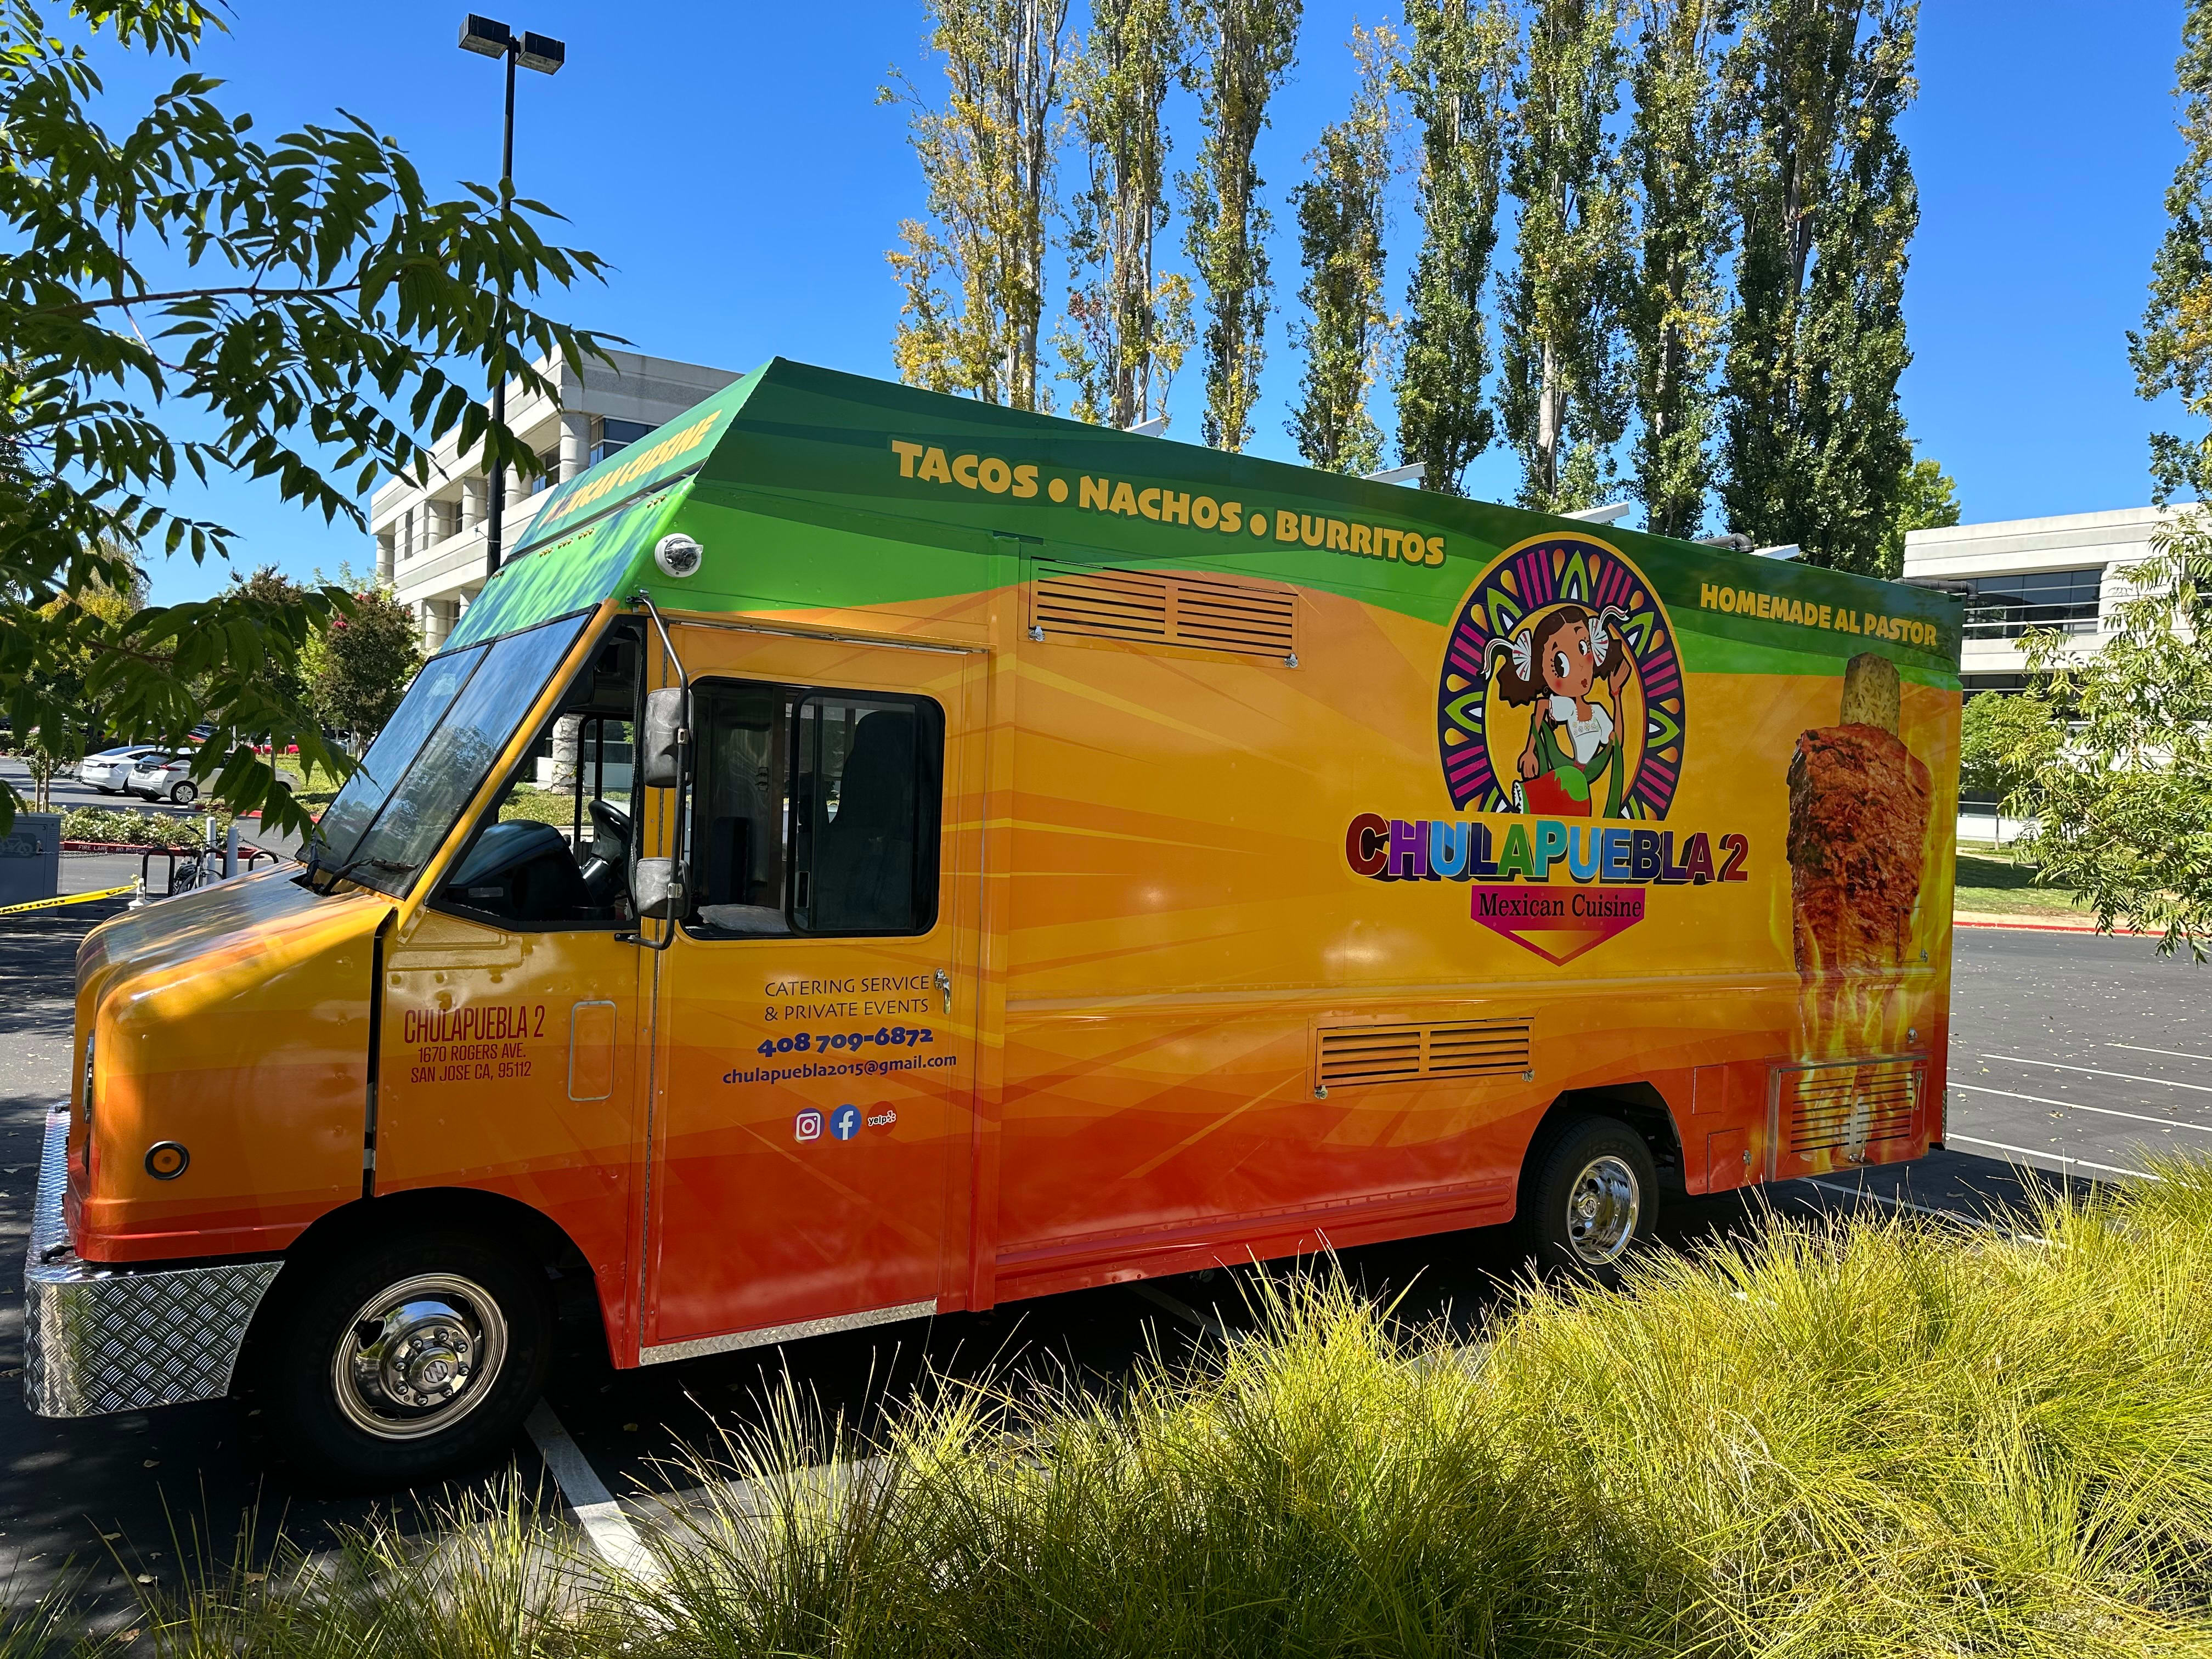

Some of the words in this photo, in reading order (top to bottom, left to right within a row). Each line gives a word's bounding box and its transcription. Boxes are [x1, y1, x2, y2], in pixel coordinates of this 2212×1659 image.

[618, 409, 722, 487] CUISINE
[891, 441, 1039, 498] TACOS
[1079, 476, 1242, 532] NACHOS
[1276, 510, 1444, 565] BURRITOS
[1700, 583, 1831, 628] HOMEMADE
[1834, 608, 1861, 634] AL
[1864, 613, 1937, 646] PASTOR
[1345, 812, 1716, 885] CHULAPUEBLA
[1718, 832, 1749, 883] 2
[1479, 893, 1565, 917] Mexican
[1572, 894, 1641, 917] Cuisine
[765, 979, 855, 996] CATERING
[861, 976, 929, 992] SERVICE
[404, 1006, 527, 1043] CHULAPUEBLA
[534, 1005, 545, 1037] 2
[765, 1007, 778, 1021] &
[785, 1002, 857, 1020] PRIVATE
[865, 999, 928, 1015] EVENTS
[417, 1046, 447, 1063] 1670
[451, 1044, 498, 1061] ROGERS
[501, 1043, 526, 1059] AVE.
[757, 1032, 810, 1058] 408
[815, 1026, 933, 1054] 709-6872
[411, 1066, 436, 1083] SAN
[439, 1065, 471, 1081] JOSE
[475, 1064, 493, 1081] CA,
[499, 1061, 532, 1078] 95112
[723, 1055, 957, 1085] chulapuebla2015@gmail.com
[868, 1115, 887, 1126] yelp
